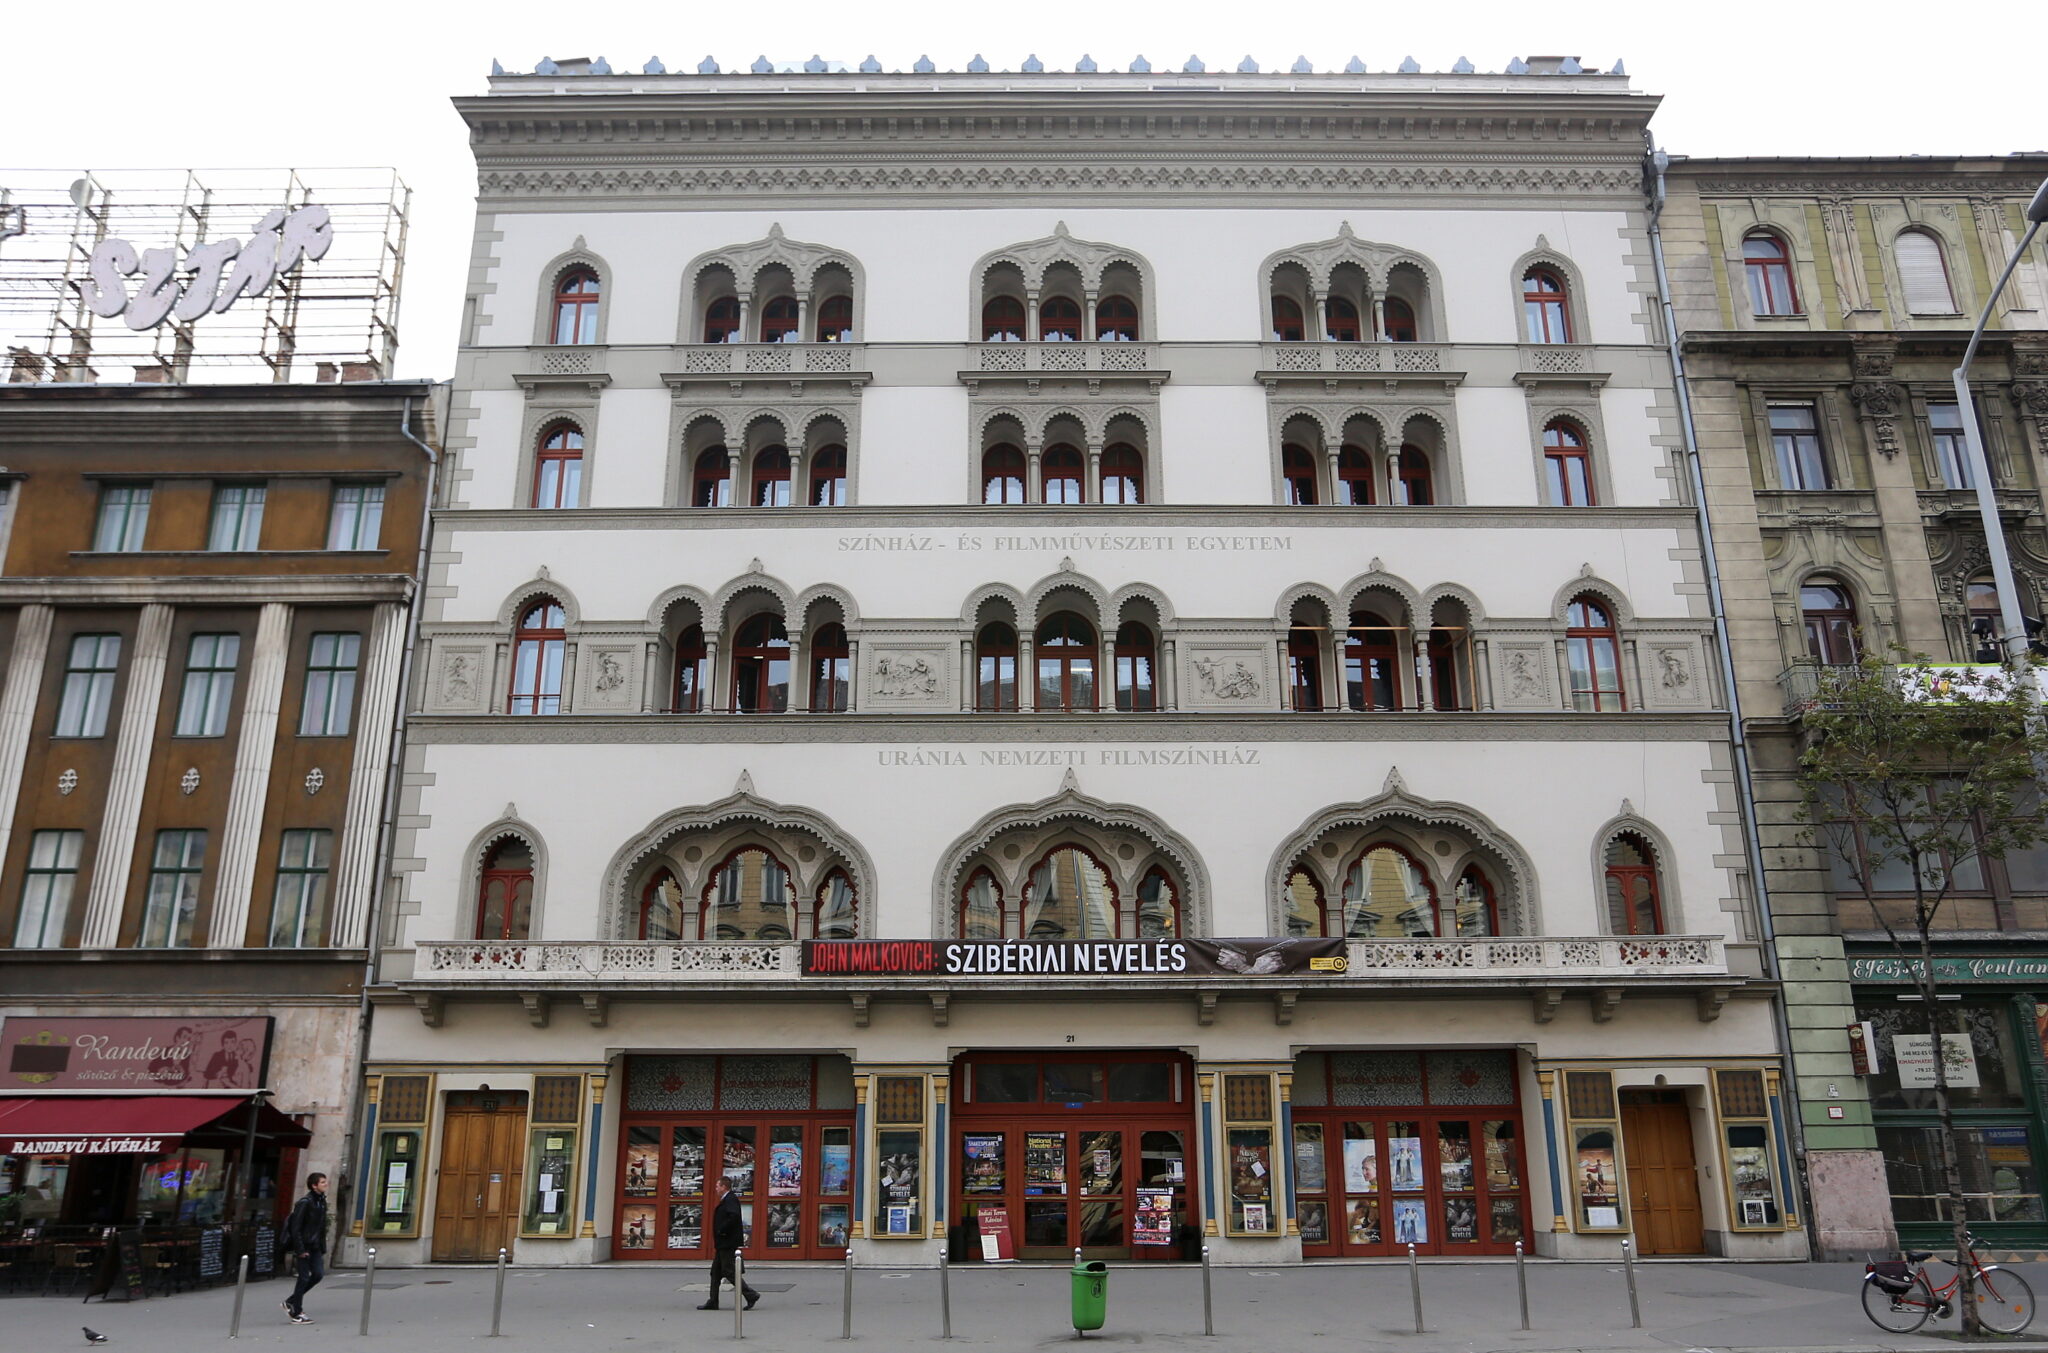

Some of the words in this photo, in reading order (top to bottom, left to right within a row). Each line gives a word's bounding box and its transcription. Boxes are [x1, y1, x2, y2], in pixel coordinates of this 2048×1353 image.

[957, 533, 982, 551] ÉS
[994, 533, 1175, 551] FILMMŰVÉSZETI
[1187, 536, 1292, 551] EGYETEM
[878, 746, 967, 766] URÁNIA
[980, 750, 1087, 766] NEMZETI
[1100, 745, 1261, 766] FILMSZÍNHÁZ
[809, 943, 848, 972] JOHN
[851, 942, 939, 972] MALKOVICH:
[945, 938, 1067, 973] SZIBÉRIAI
[1073, 937, 1186, 972] NEVELÉS
[76, 1034, 193, 1061] Randevú
[1066, 1035, 1075, 1043] 21
[121, 1067, 135, 1080] &
[134, 1069, 185, 1085] pizzéria
[11, 1138, 88, 1154] RANDEVÚ
[88, 1137, 162, 1153] KÁVÉHÁZ
